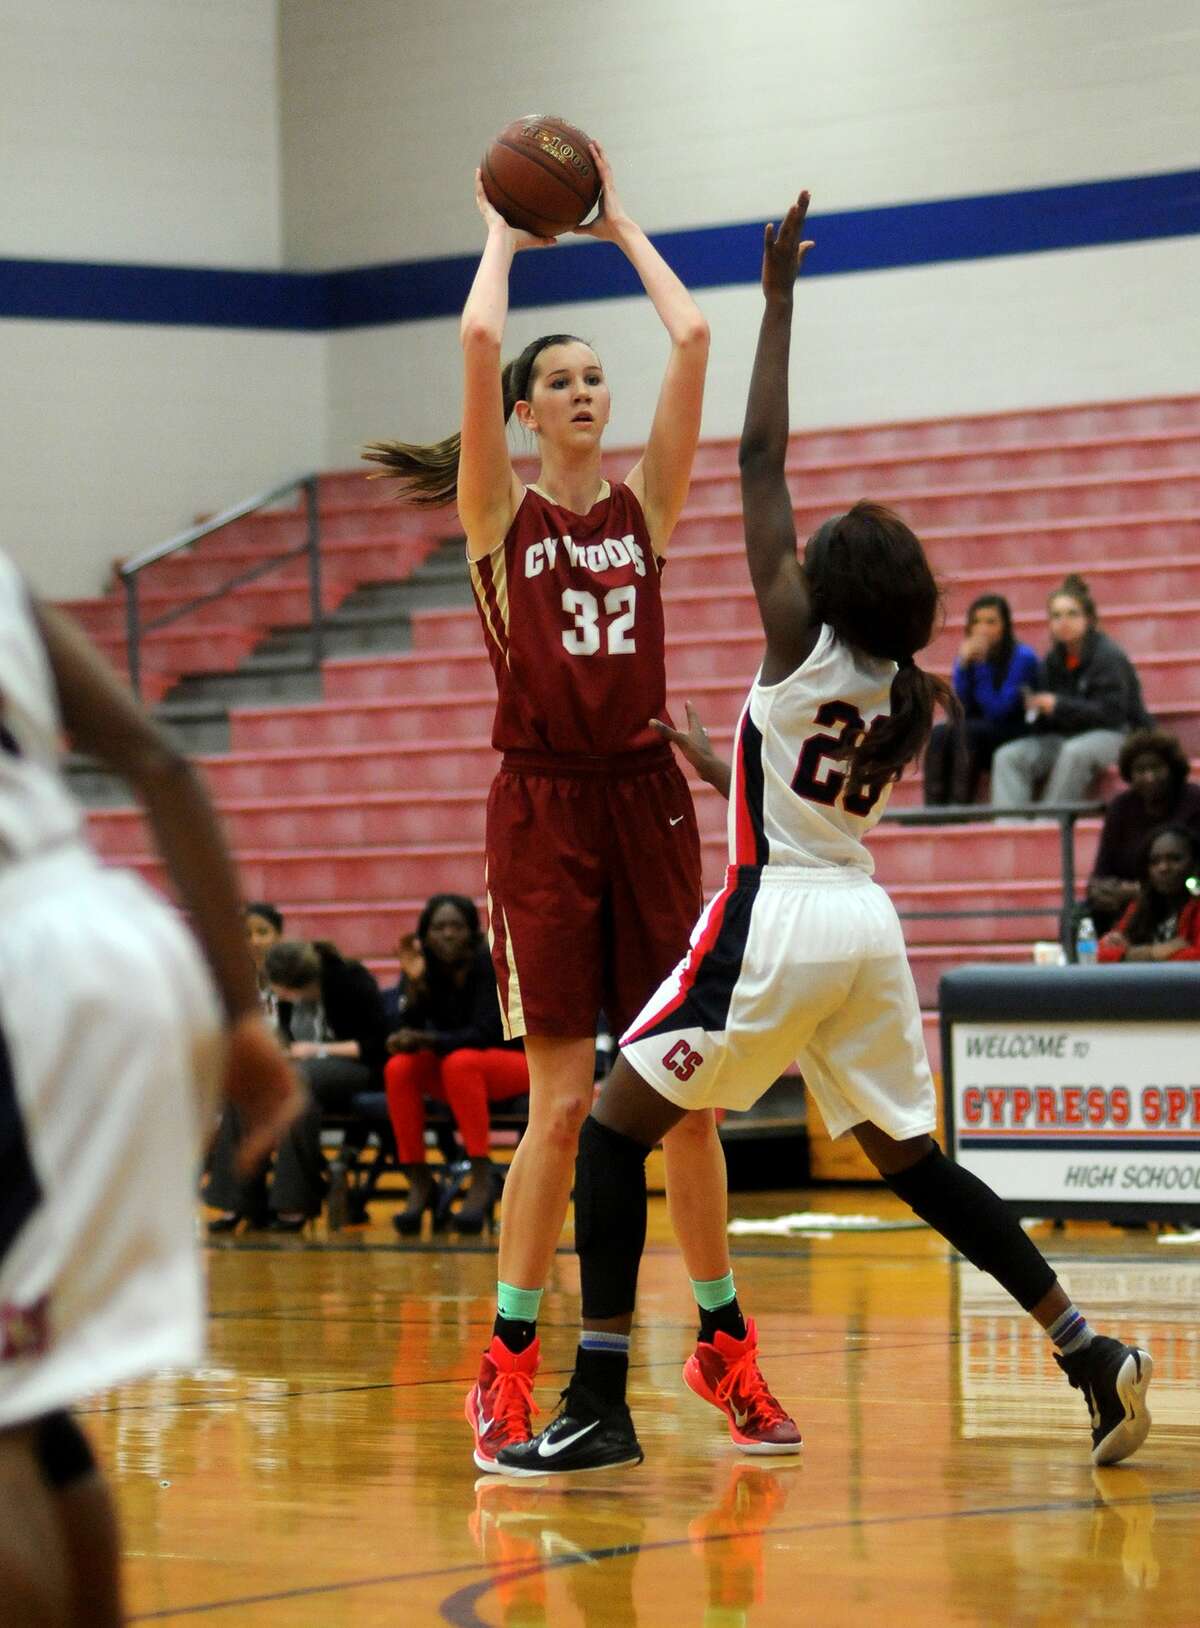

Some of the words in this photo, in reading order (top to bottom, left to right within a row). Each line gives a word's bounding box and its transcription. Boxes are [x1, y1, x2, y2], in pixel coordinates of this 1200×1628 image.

[524, 536, 559, 579] CY
[561, 584, 637, 656] 32
[662, 1039, 704, 1082] CS
[965, 1034, 1070, 1059] WELCOME
[962, 1086, 1131, 1127] CYPRESS
[1064, 1165, 1118, 1189] HIGH
